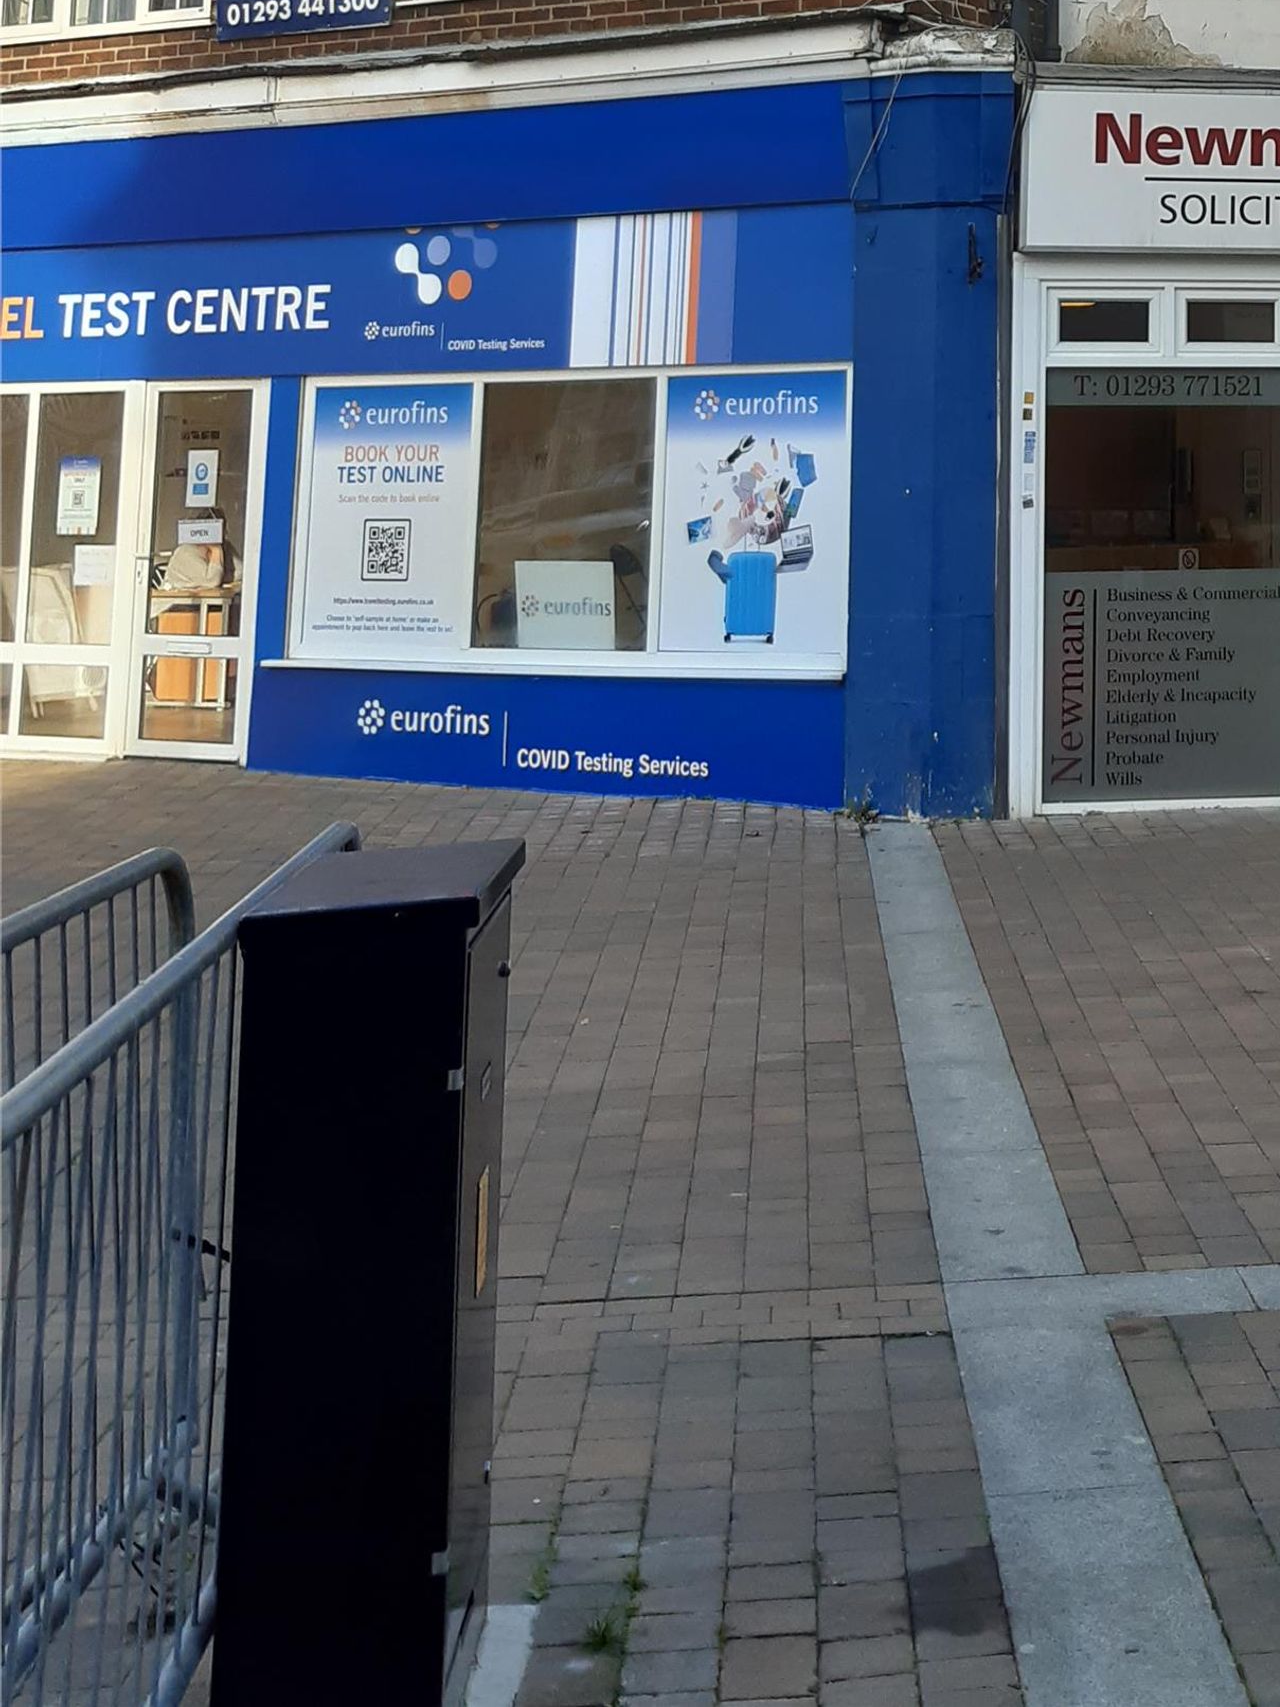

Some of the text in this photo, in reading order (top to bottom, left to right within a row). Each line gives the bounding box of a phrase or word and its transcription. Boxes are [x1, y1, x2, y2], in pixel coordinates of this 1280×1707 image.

[0, 284, 331, 338] EL TEST CENTRE
[382, 321, 435, 337] eurofins
[448, 338, 545, 352] COVID Testing Services
[1073, 374, 1263, 396] T: 01293 771521
[726, 389, 819, 415] eurofins
[366, 400, 449, 424] eurofins
[344, 444, 440, 463] BOOK YOUR
[337, 465, 445, 483] TEST ONLINE
[338, 494, 356, 503] Scan
[358, 494, 369, 503] the
[399, 494, 416, 503] book
[190, 529, 209, 537] OPEN
[1107, 585, 1280, 602] Business & Commercial
[544, 596, 611, 618] eurofins
[1106, 608, 1211, 624] Conveyancing
[1106, 628, 1215, 643] Debt Recovery
[1106, 646, 1235, 663] Divorce & Family
[1106, 669, 1199, 685] Employment
[1051, 588, 1086, 785] Newmans
[1105, 687, 1257, 705] Elderly & Incapacity
[391, 705, 489, 735] eurofins
[1106, 710, 1177, 726] Litigation
[1106, 729, 1219, 745] Personal Injury
[517, 748, 709, 778] COVID Testing Services
[1105, 751, 1164, 766] Probate
[1105, 771, 1143, 786] Wills
